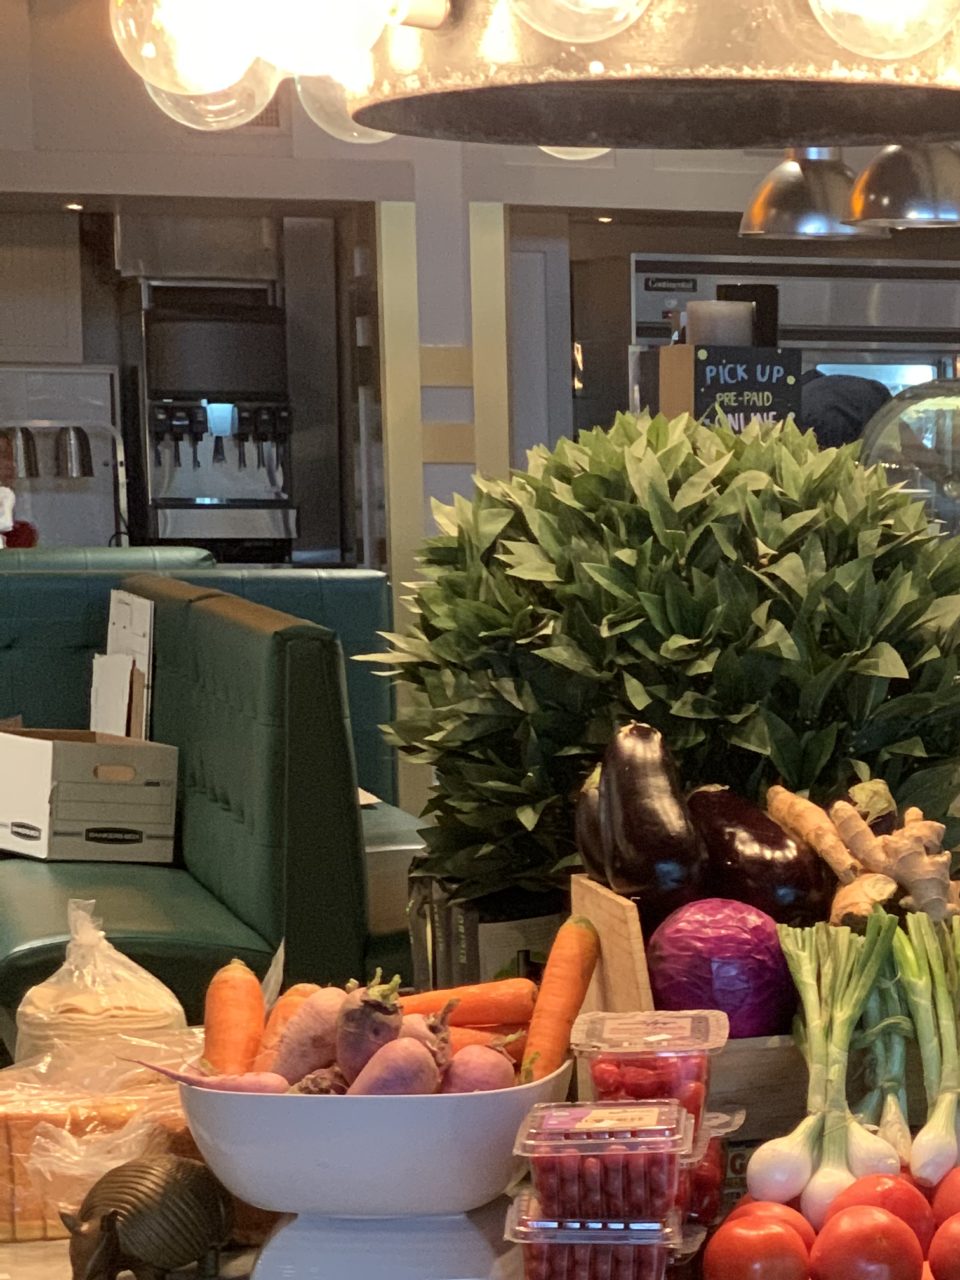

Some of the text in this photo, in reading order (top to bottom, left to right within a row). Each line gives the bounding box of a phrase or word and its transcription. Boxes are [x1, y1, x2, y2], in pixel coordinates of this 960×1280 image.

[705, 363, 784, 385] PICK UP
[715, 391, 773, 407] PRE-PAID
